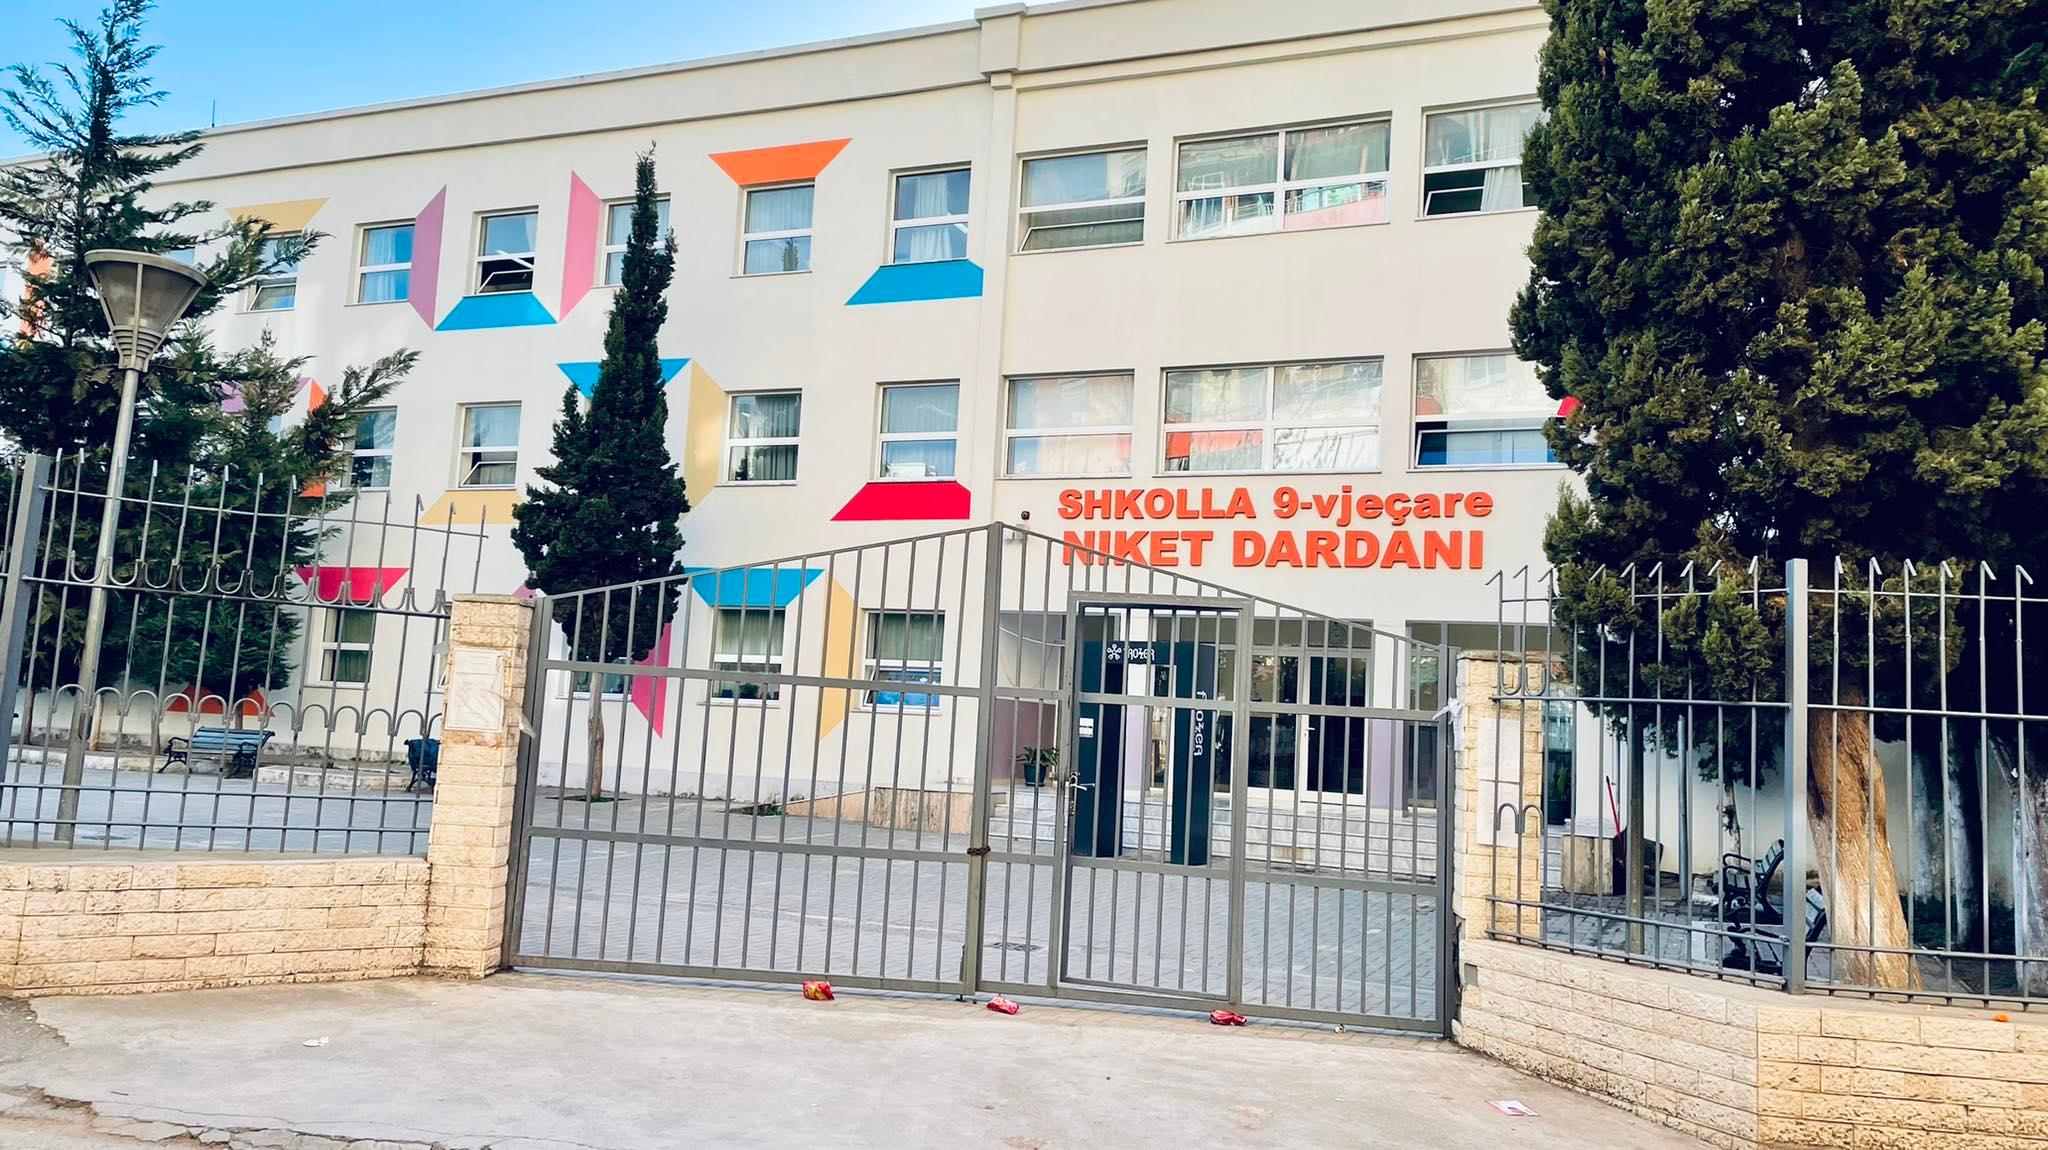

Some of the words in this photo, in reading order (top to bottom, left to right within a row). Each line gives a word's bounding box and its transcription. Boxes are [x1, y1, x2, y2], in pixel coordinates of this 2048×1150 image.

[1058, 488, 1256, 520] SHKOLLA
[1273, 486, 1494, 527] 9-vjeçare
[1063, 530, 1213, 567] NIKET
[1232, 530, 1484, 570] DARDANI
[1193, 690, 1208, 756] fozen
